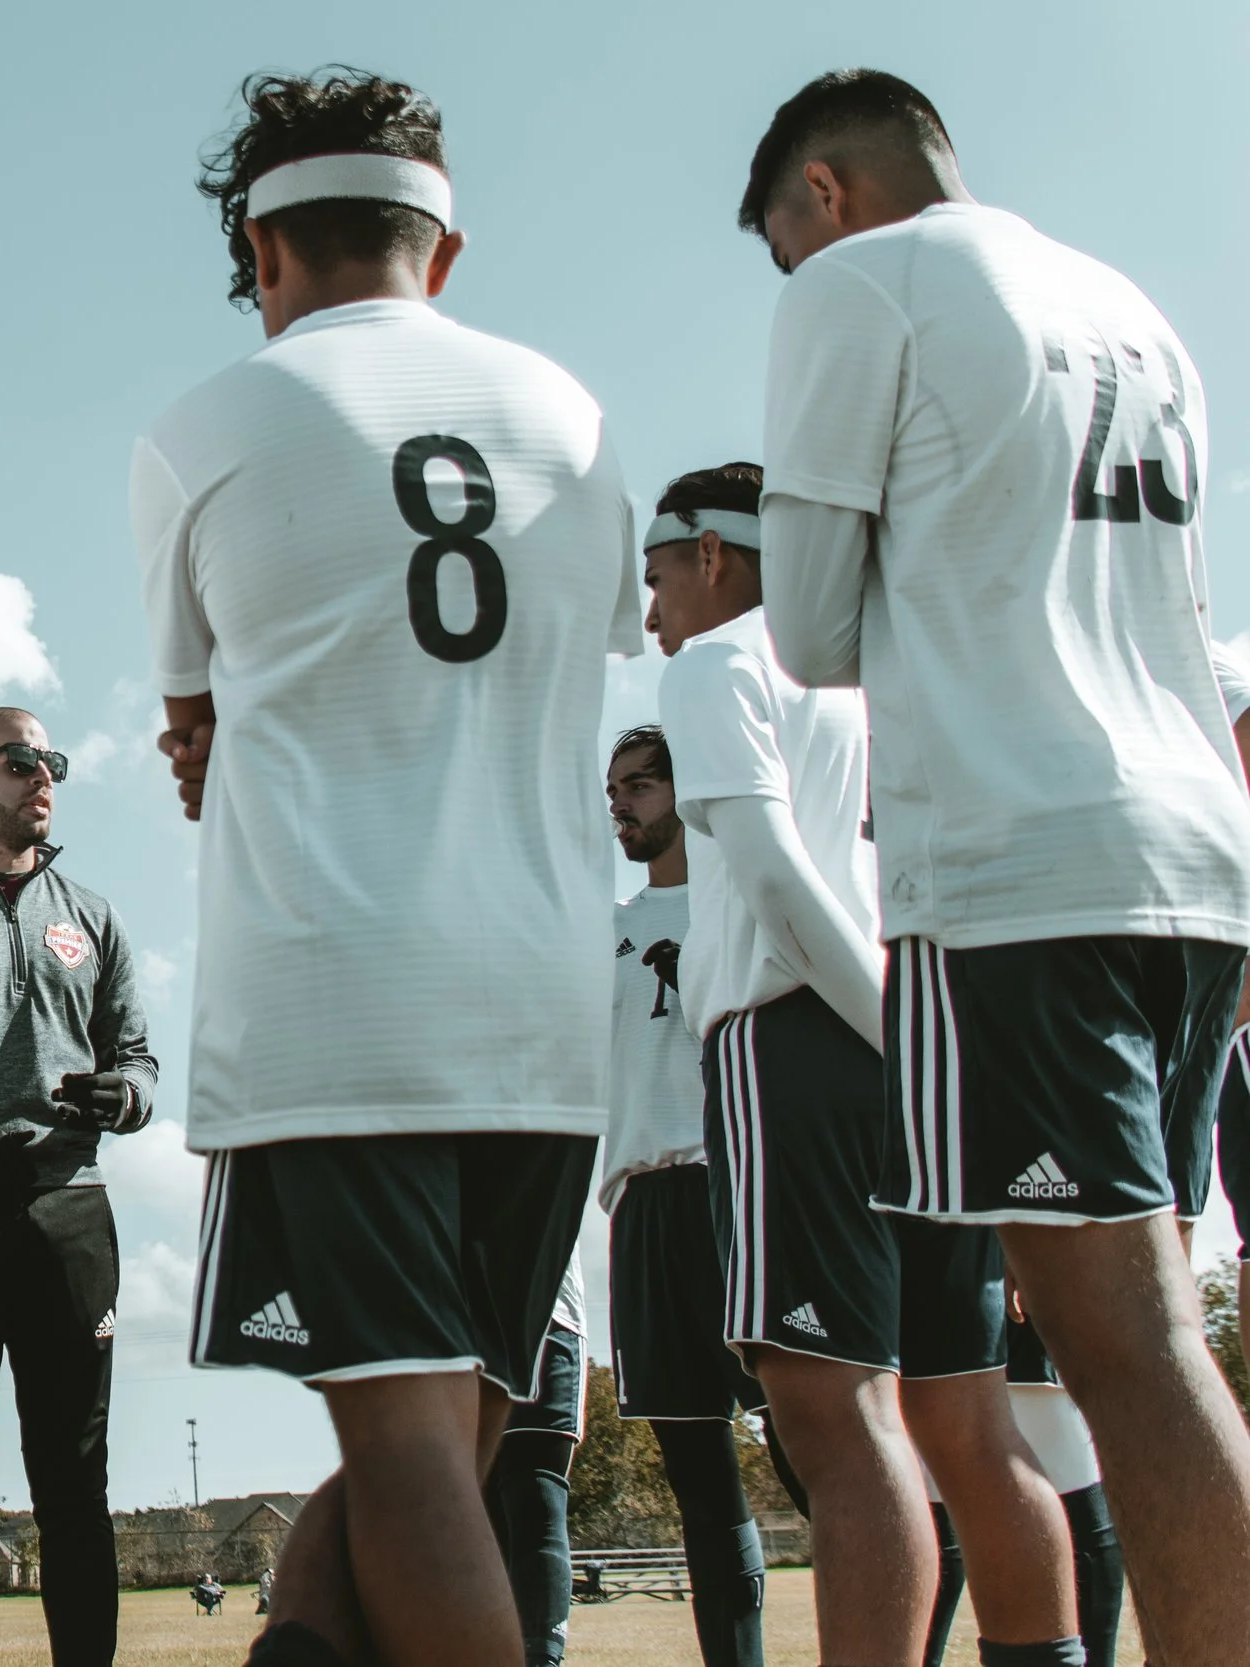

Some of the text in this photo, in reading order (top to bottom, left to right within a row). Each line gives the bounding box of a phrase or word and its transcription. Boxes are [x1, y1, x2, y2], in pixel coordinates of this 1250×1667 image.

[1041, 325, 1198, 526] 23
[392, 434, 507, 664] 8
[1007, 1181, 1080, 1199] adidas
[239, 1320, 310, 1346] adidas
[782, 1315, 828, 1338] adidas
